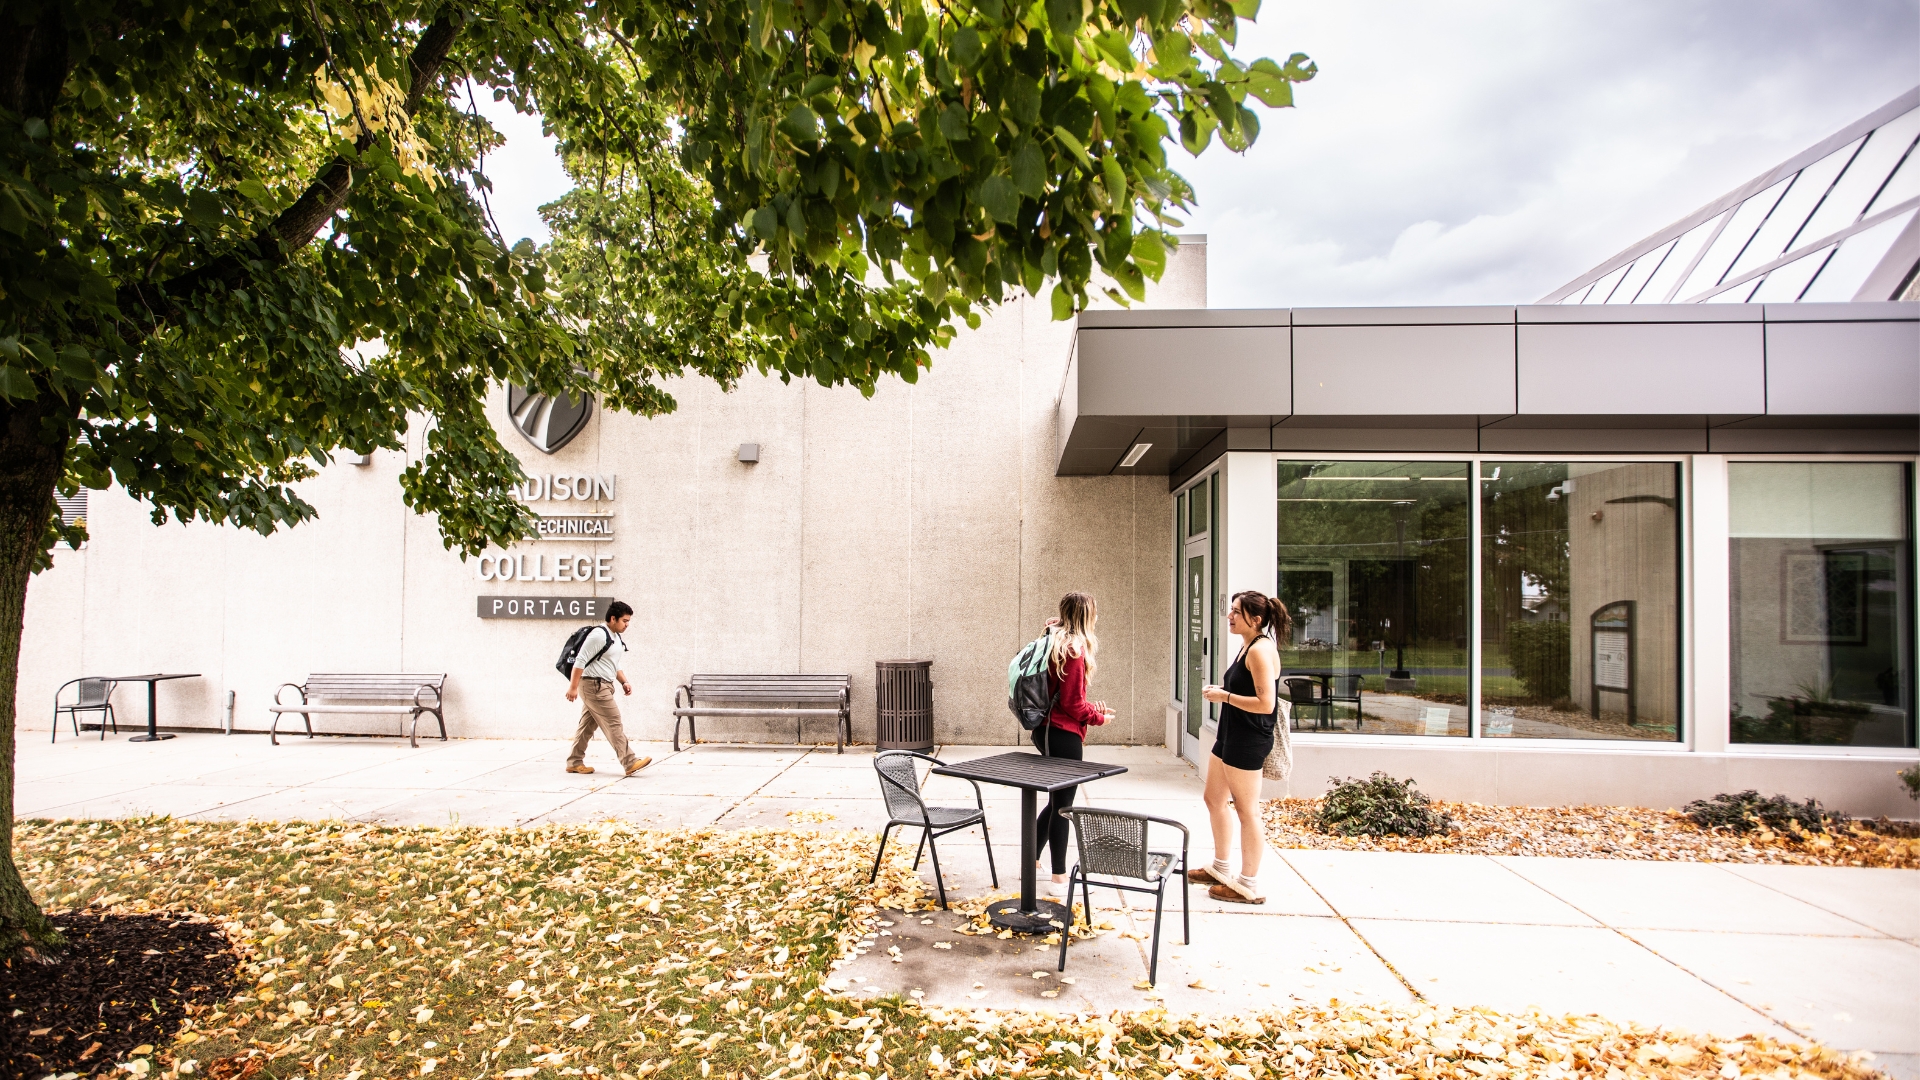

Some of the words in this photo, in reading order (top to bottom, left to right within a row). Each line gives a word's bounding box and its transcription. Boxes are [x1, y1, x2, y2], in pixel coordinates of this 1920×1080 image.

[495, 474, 615, 501] ADISON
[478, 554, 614, 582] COLLEGE
[493, 600, 596, 616] PORTAGE
